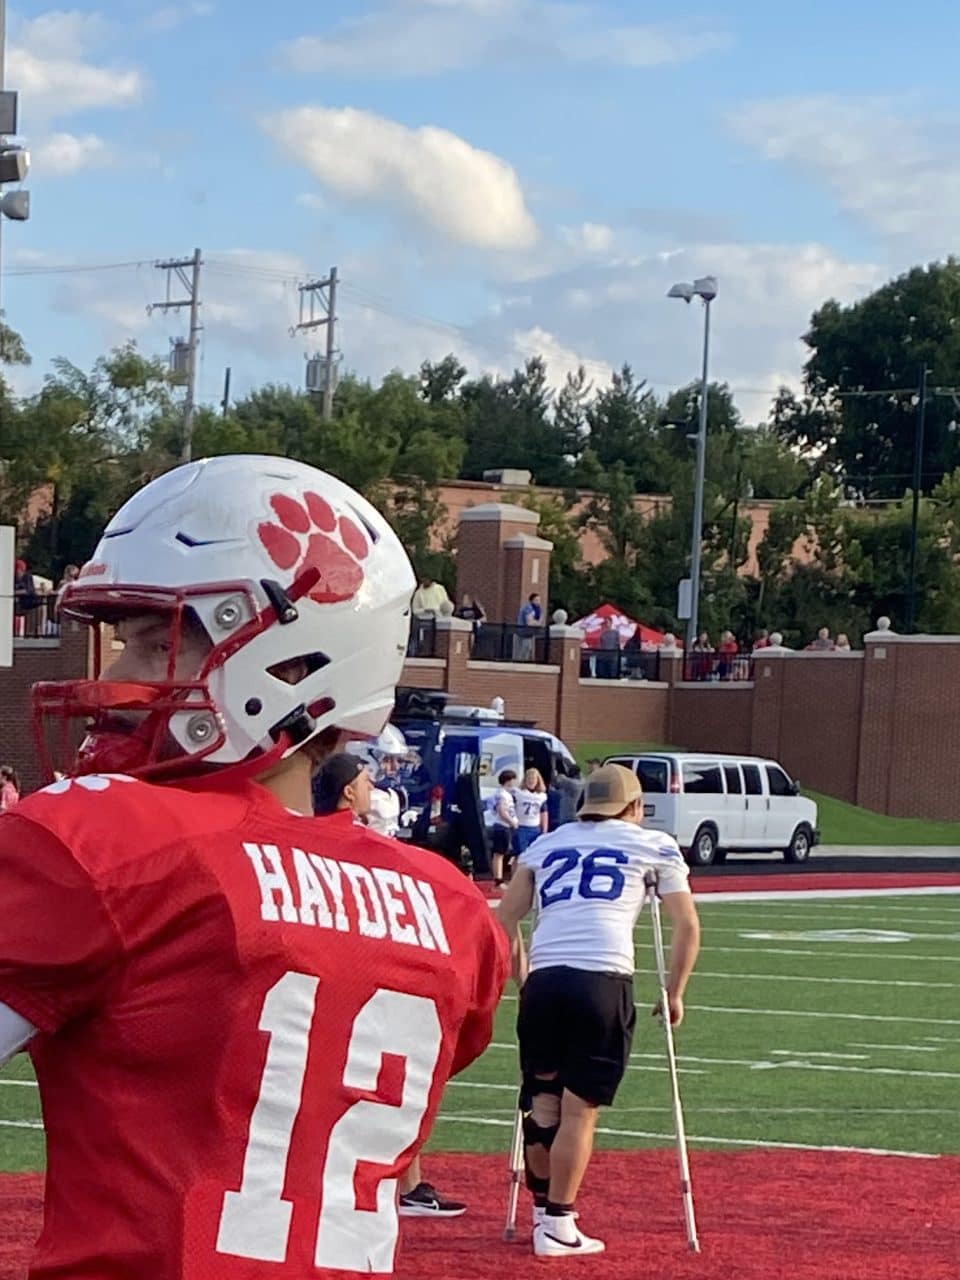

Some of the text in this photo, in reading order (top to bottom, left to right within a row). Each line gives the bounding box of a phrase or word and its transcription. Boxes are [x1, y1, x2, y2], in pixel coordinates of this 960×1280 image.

[243, 842, 451, 955] HAYDEN
[540, 848, 629, 908] 26
[216, 970, 442, 1273] 12
